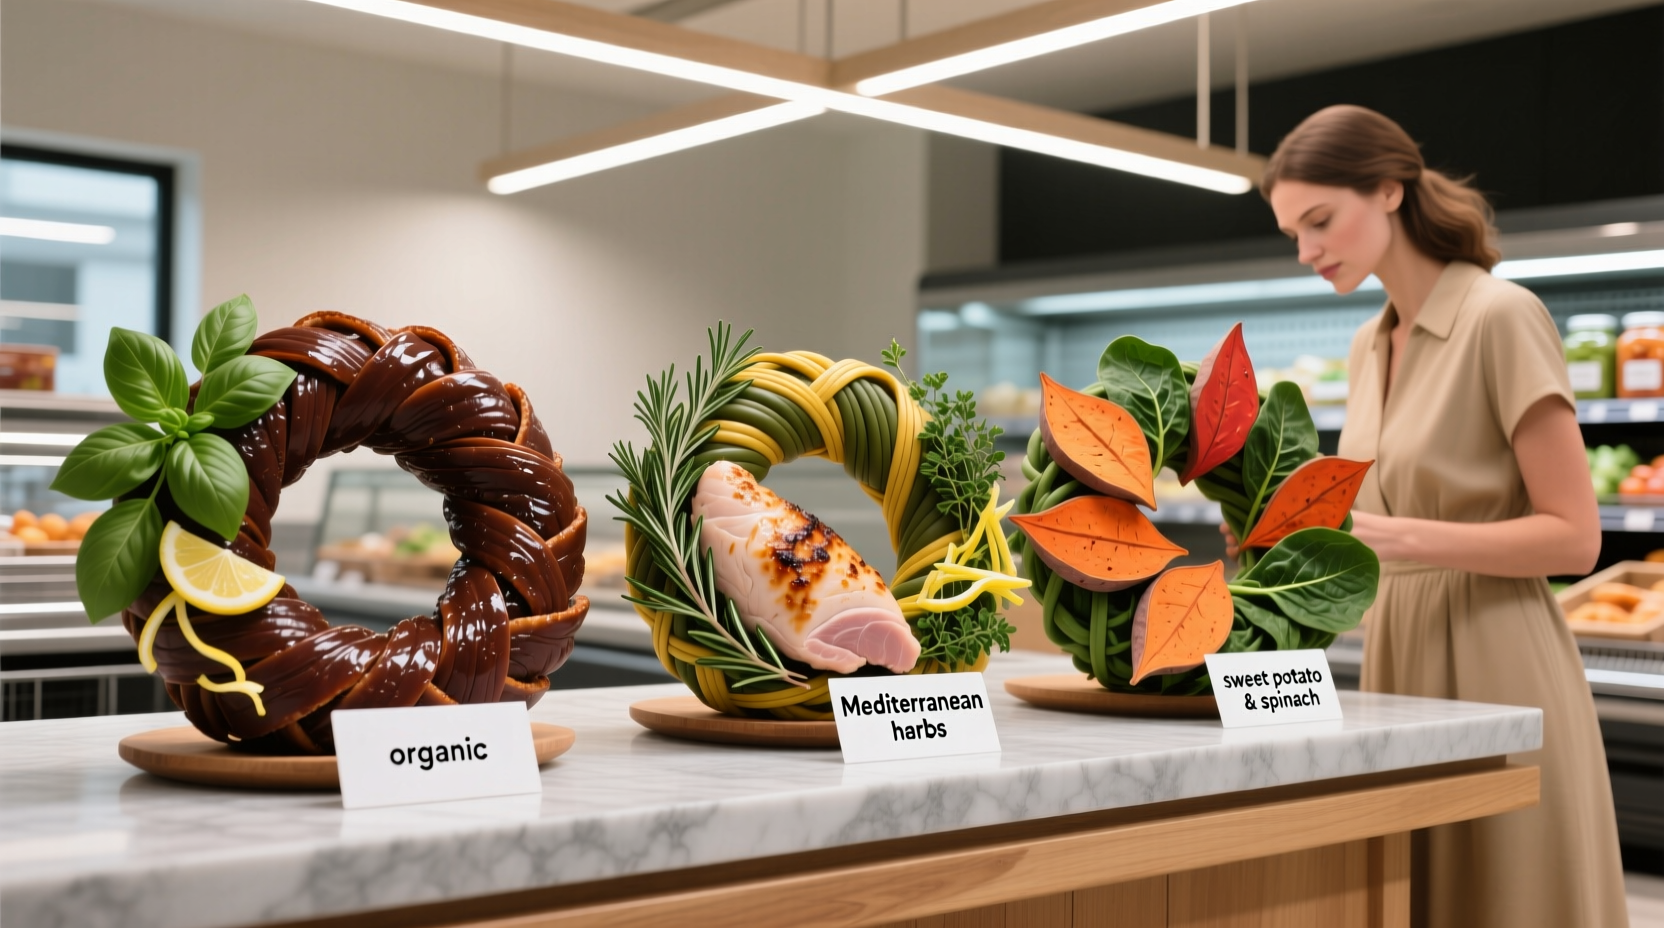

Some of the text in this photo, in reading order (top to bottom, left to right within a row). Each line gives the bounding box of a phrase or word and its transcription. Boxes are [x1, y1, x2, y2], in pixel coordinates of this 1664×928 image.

[1223, 667, 1323, 689] sweet potato
[840, 692, 984, 718] Mediterranean
[1244, 687, 1321, 714] & spinach
[389, 736, 488, 771] organic
